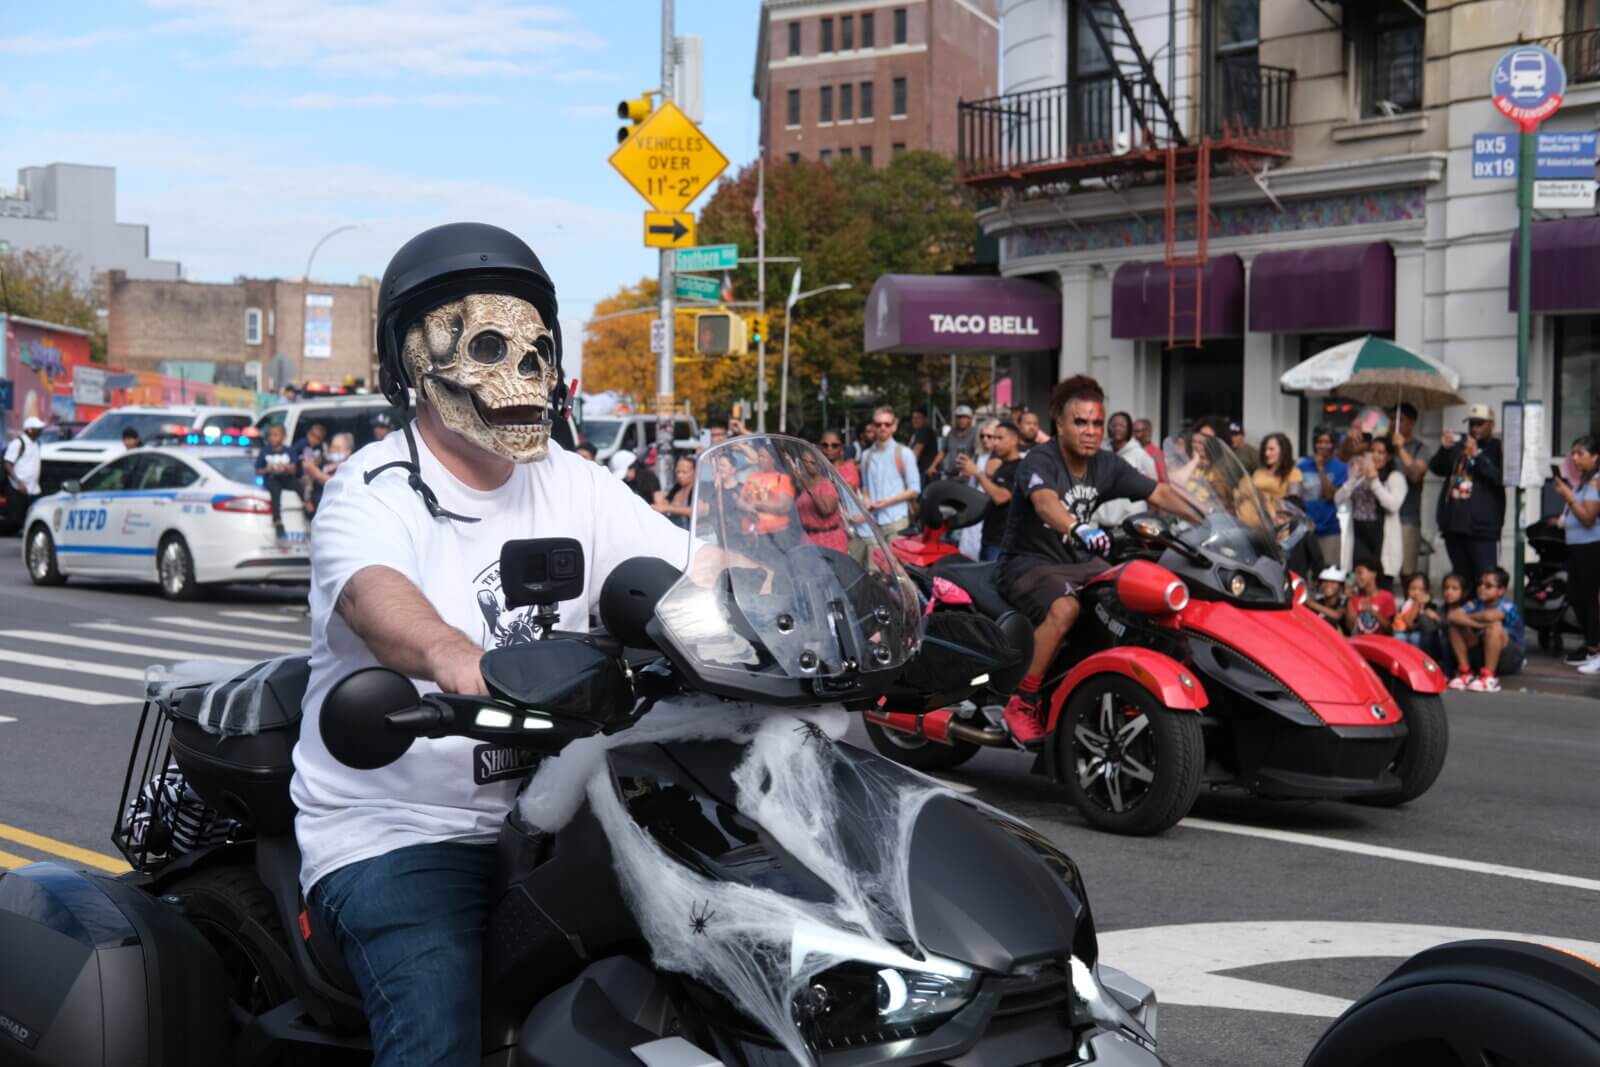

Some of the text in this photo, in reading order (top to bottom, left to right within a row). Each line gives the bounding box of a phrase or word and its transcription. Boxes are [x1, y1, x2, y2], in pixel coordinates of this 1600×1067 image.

[637, 136, 703, 152] VEHICLES
[1475, 136, 1506, 154] BX5
[647, 156, 691, 170] OVER
[1474, 159, 1515, 176] BX19
[647, 176, 699, 197] 11'-2"
[929, 314, 1039, 335] TACO BELL
[65, 508, 108, 531] NYPD
[481, 569, 502, 586] TEA
